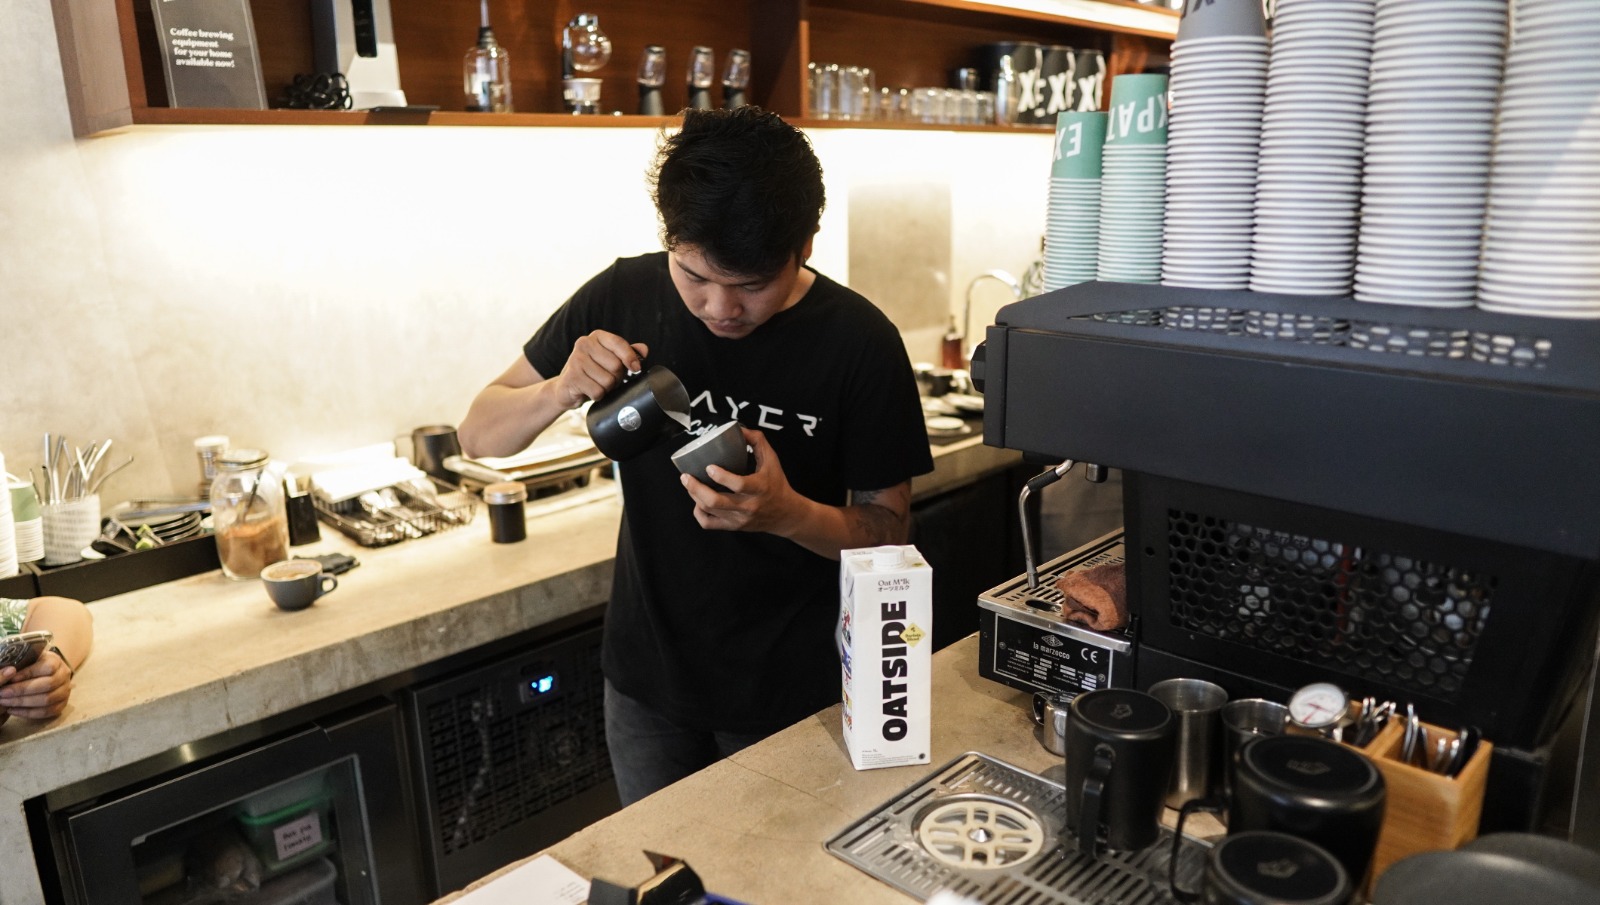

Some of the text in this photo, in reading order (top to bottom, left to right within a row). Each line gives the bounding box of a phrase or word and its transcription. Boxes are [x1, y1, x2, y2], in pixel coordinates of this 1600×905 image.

[170, 27, 234, 41] Coffee brewing
[172, 38, 219, 48] equipment
[174, 47, 233, 58] for your home
[175, 57, 214, 67] available
[1106, 92, 1168, 142] XPAT
[878, 578, 910, 587] Oat Mlk
[1040, 645, 1070, 660] marzocco
[1081, 648, 1098, 664] CE
[882, 601, 908, 741] OATSIDE
